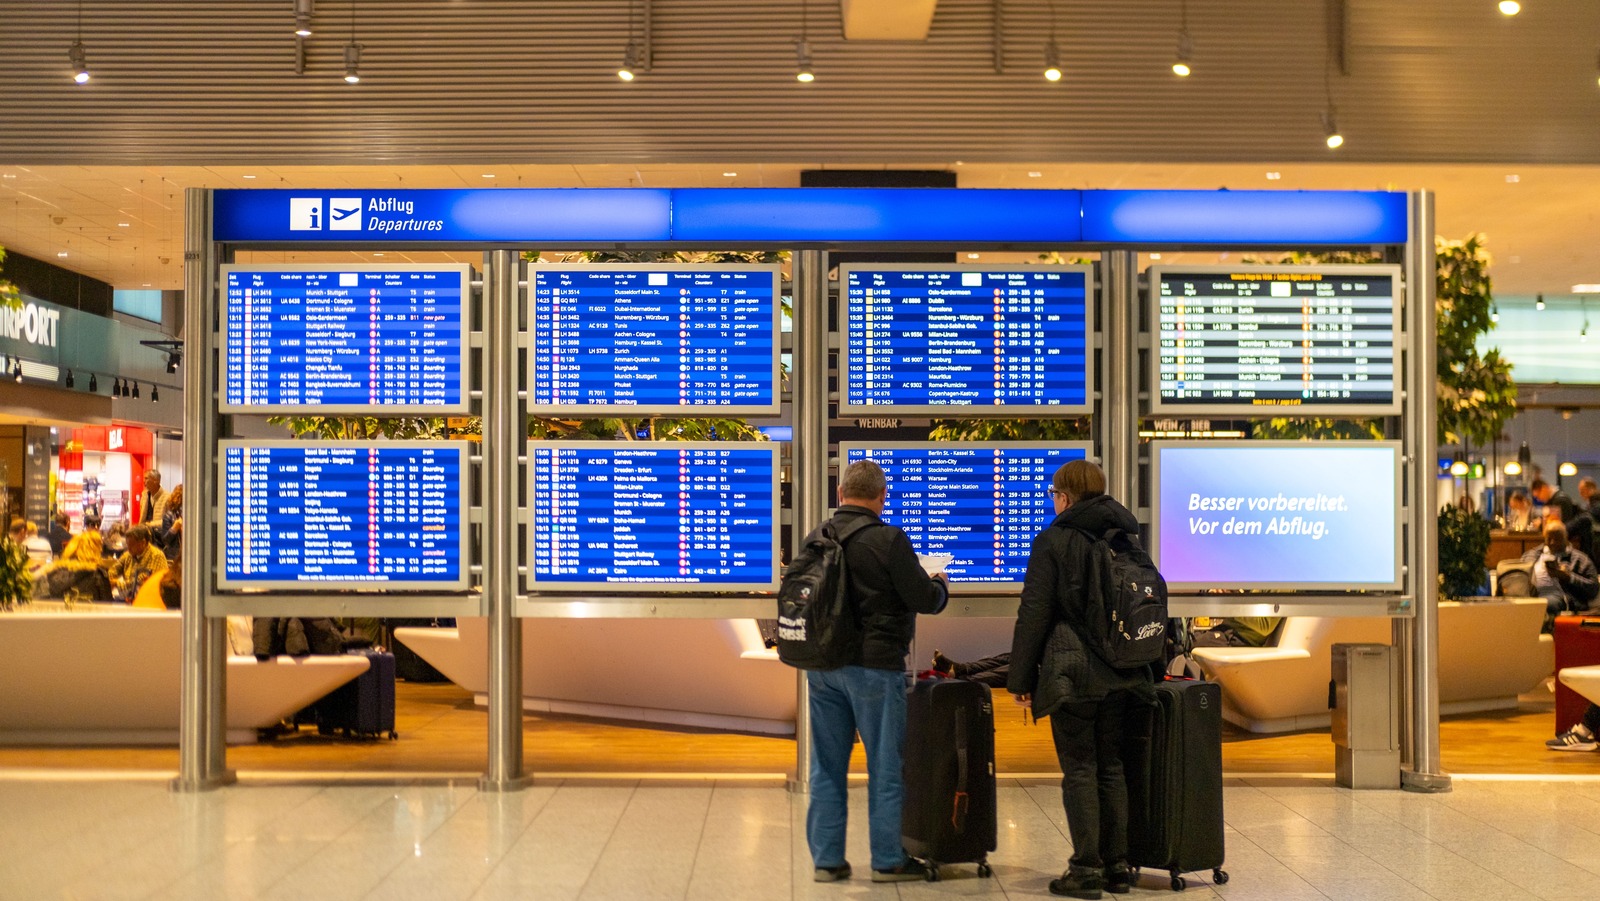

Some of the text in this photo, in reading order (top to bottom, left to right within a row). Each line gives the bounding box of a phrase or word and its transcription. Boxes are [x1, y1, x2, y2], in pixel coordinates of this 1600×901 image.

[368, 198, 414, 215] Abflug
[368, 217, 443, 233] Departures
[858, 418, 898, 428] WEINBAR
[1154, 419, 1178, 431] WEIN
[1188, 493, 1349, 511] Besser vorbereitet.
[1188, 517, 1330, 540] Vor dem Abflug.
